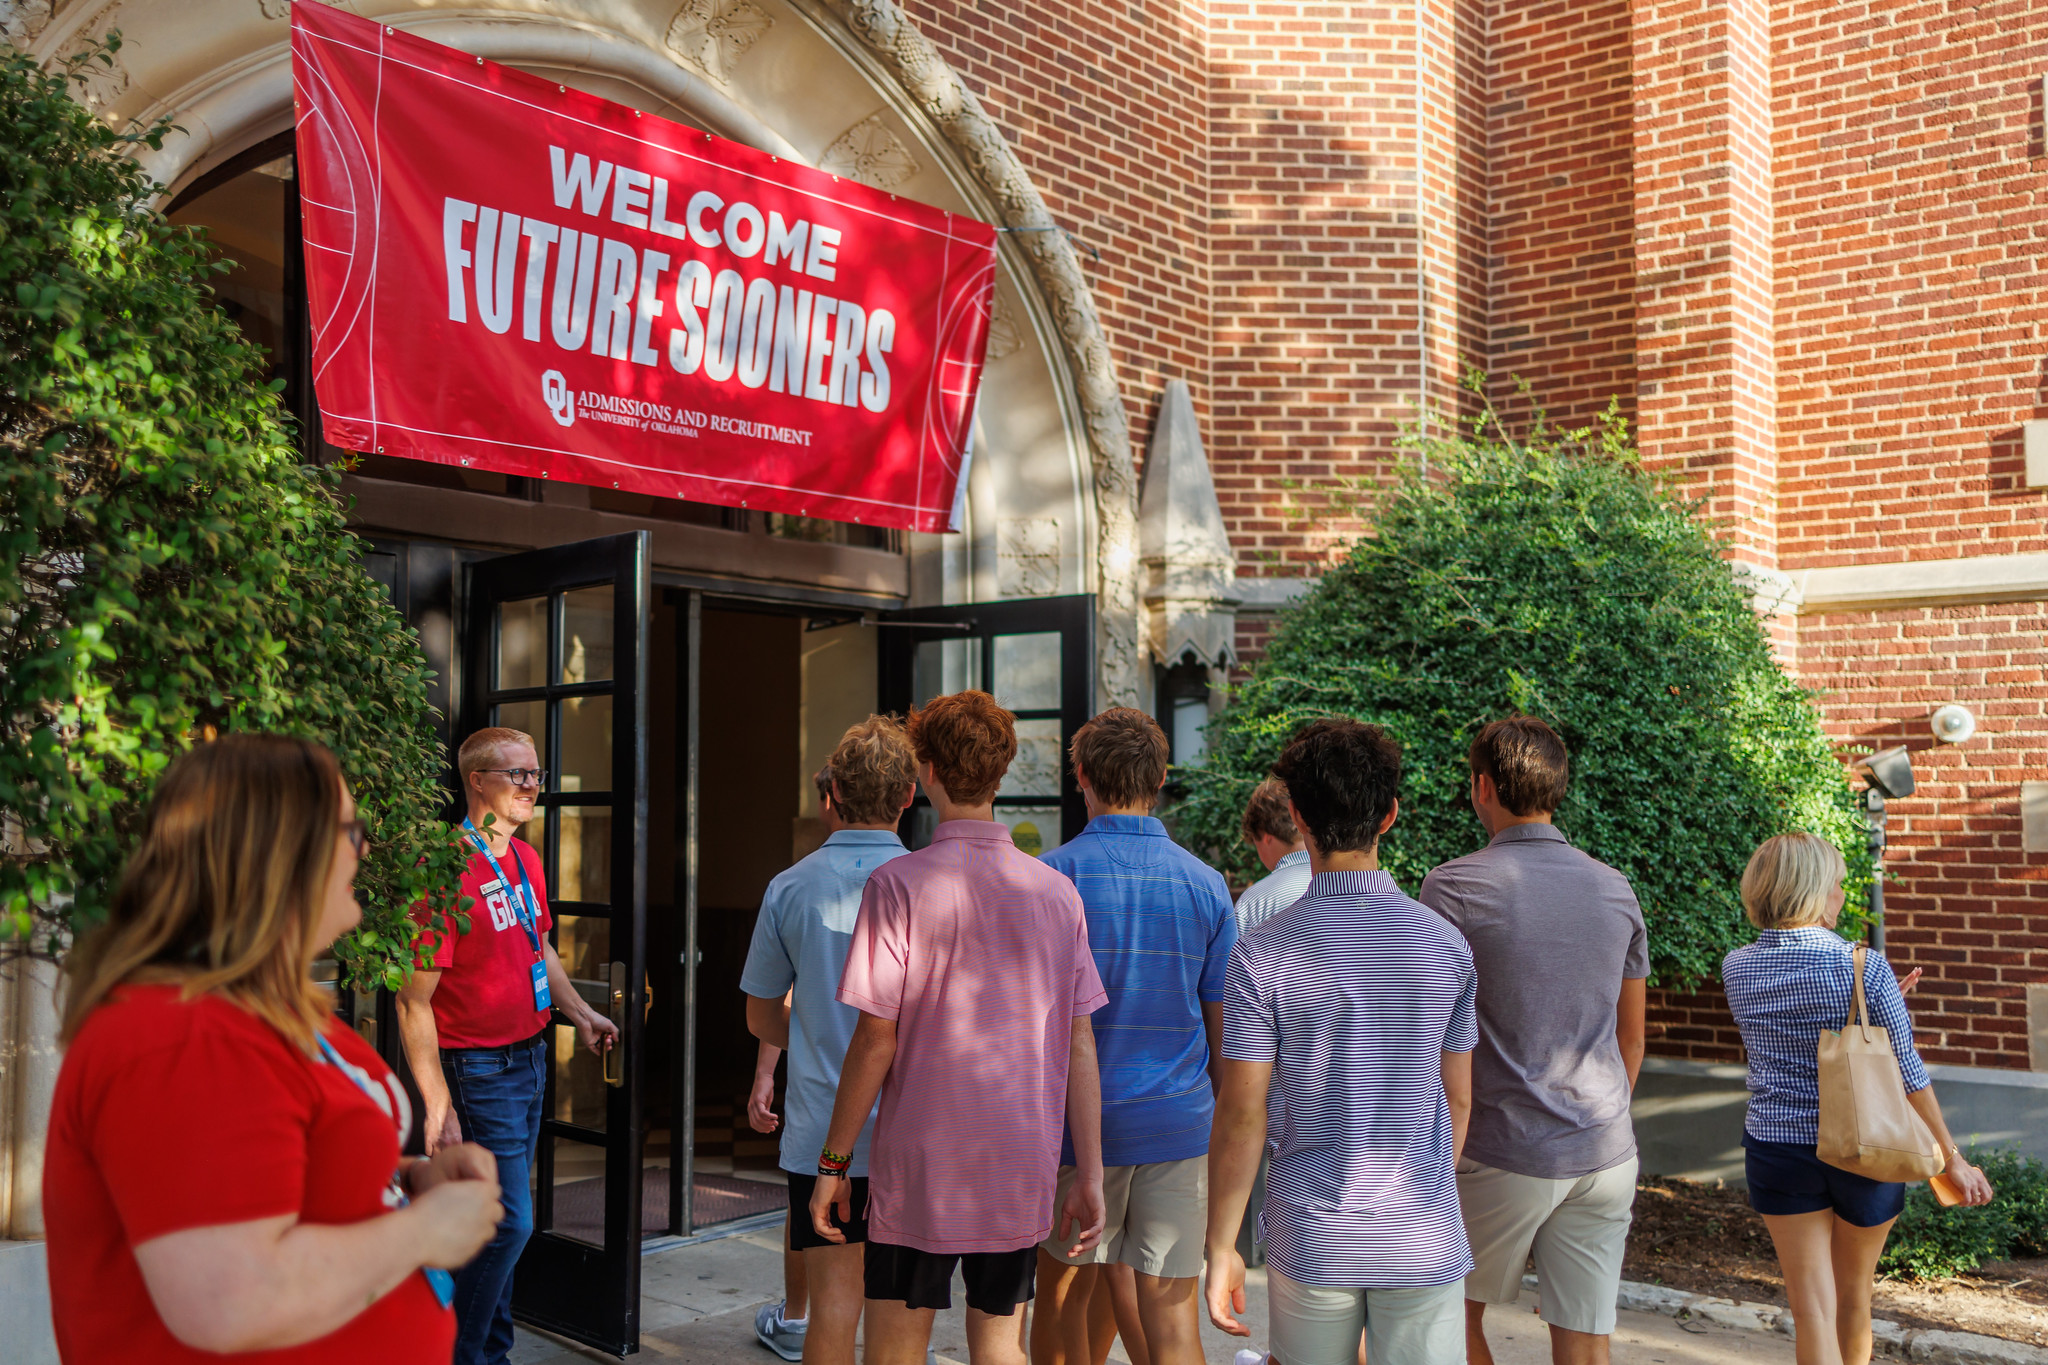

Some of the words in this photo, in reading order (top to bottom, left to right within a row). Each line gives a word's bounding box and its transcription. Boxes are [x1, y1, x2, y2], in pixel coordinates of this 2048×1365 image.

[548, 144, 842, 282] WELCOME
[443, 196, 671, 368] FUTURE
[669, 259, 896, 413] SOONERS
[577, 390, 672, 423] ADMISSIONS
[674, 409, 708, 429] AND
[710, 416, 813, 446] RECRUITMENT
[578, 408, 590, 419] The
[590, 410, 641, 429] UNIVERSITY
[640, 421, 650, 432] of
[650, 422, 699, 438] OKLAHOMA
